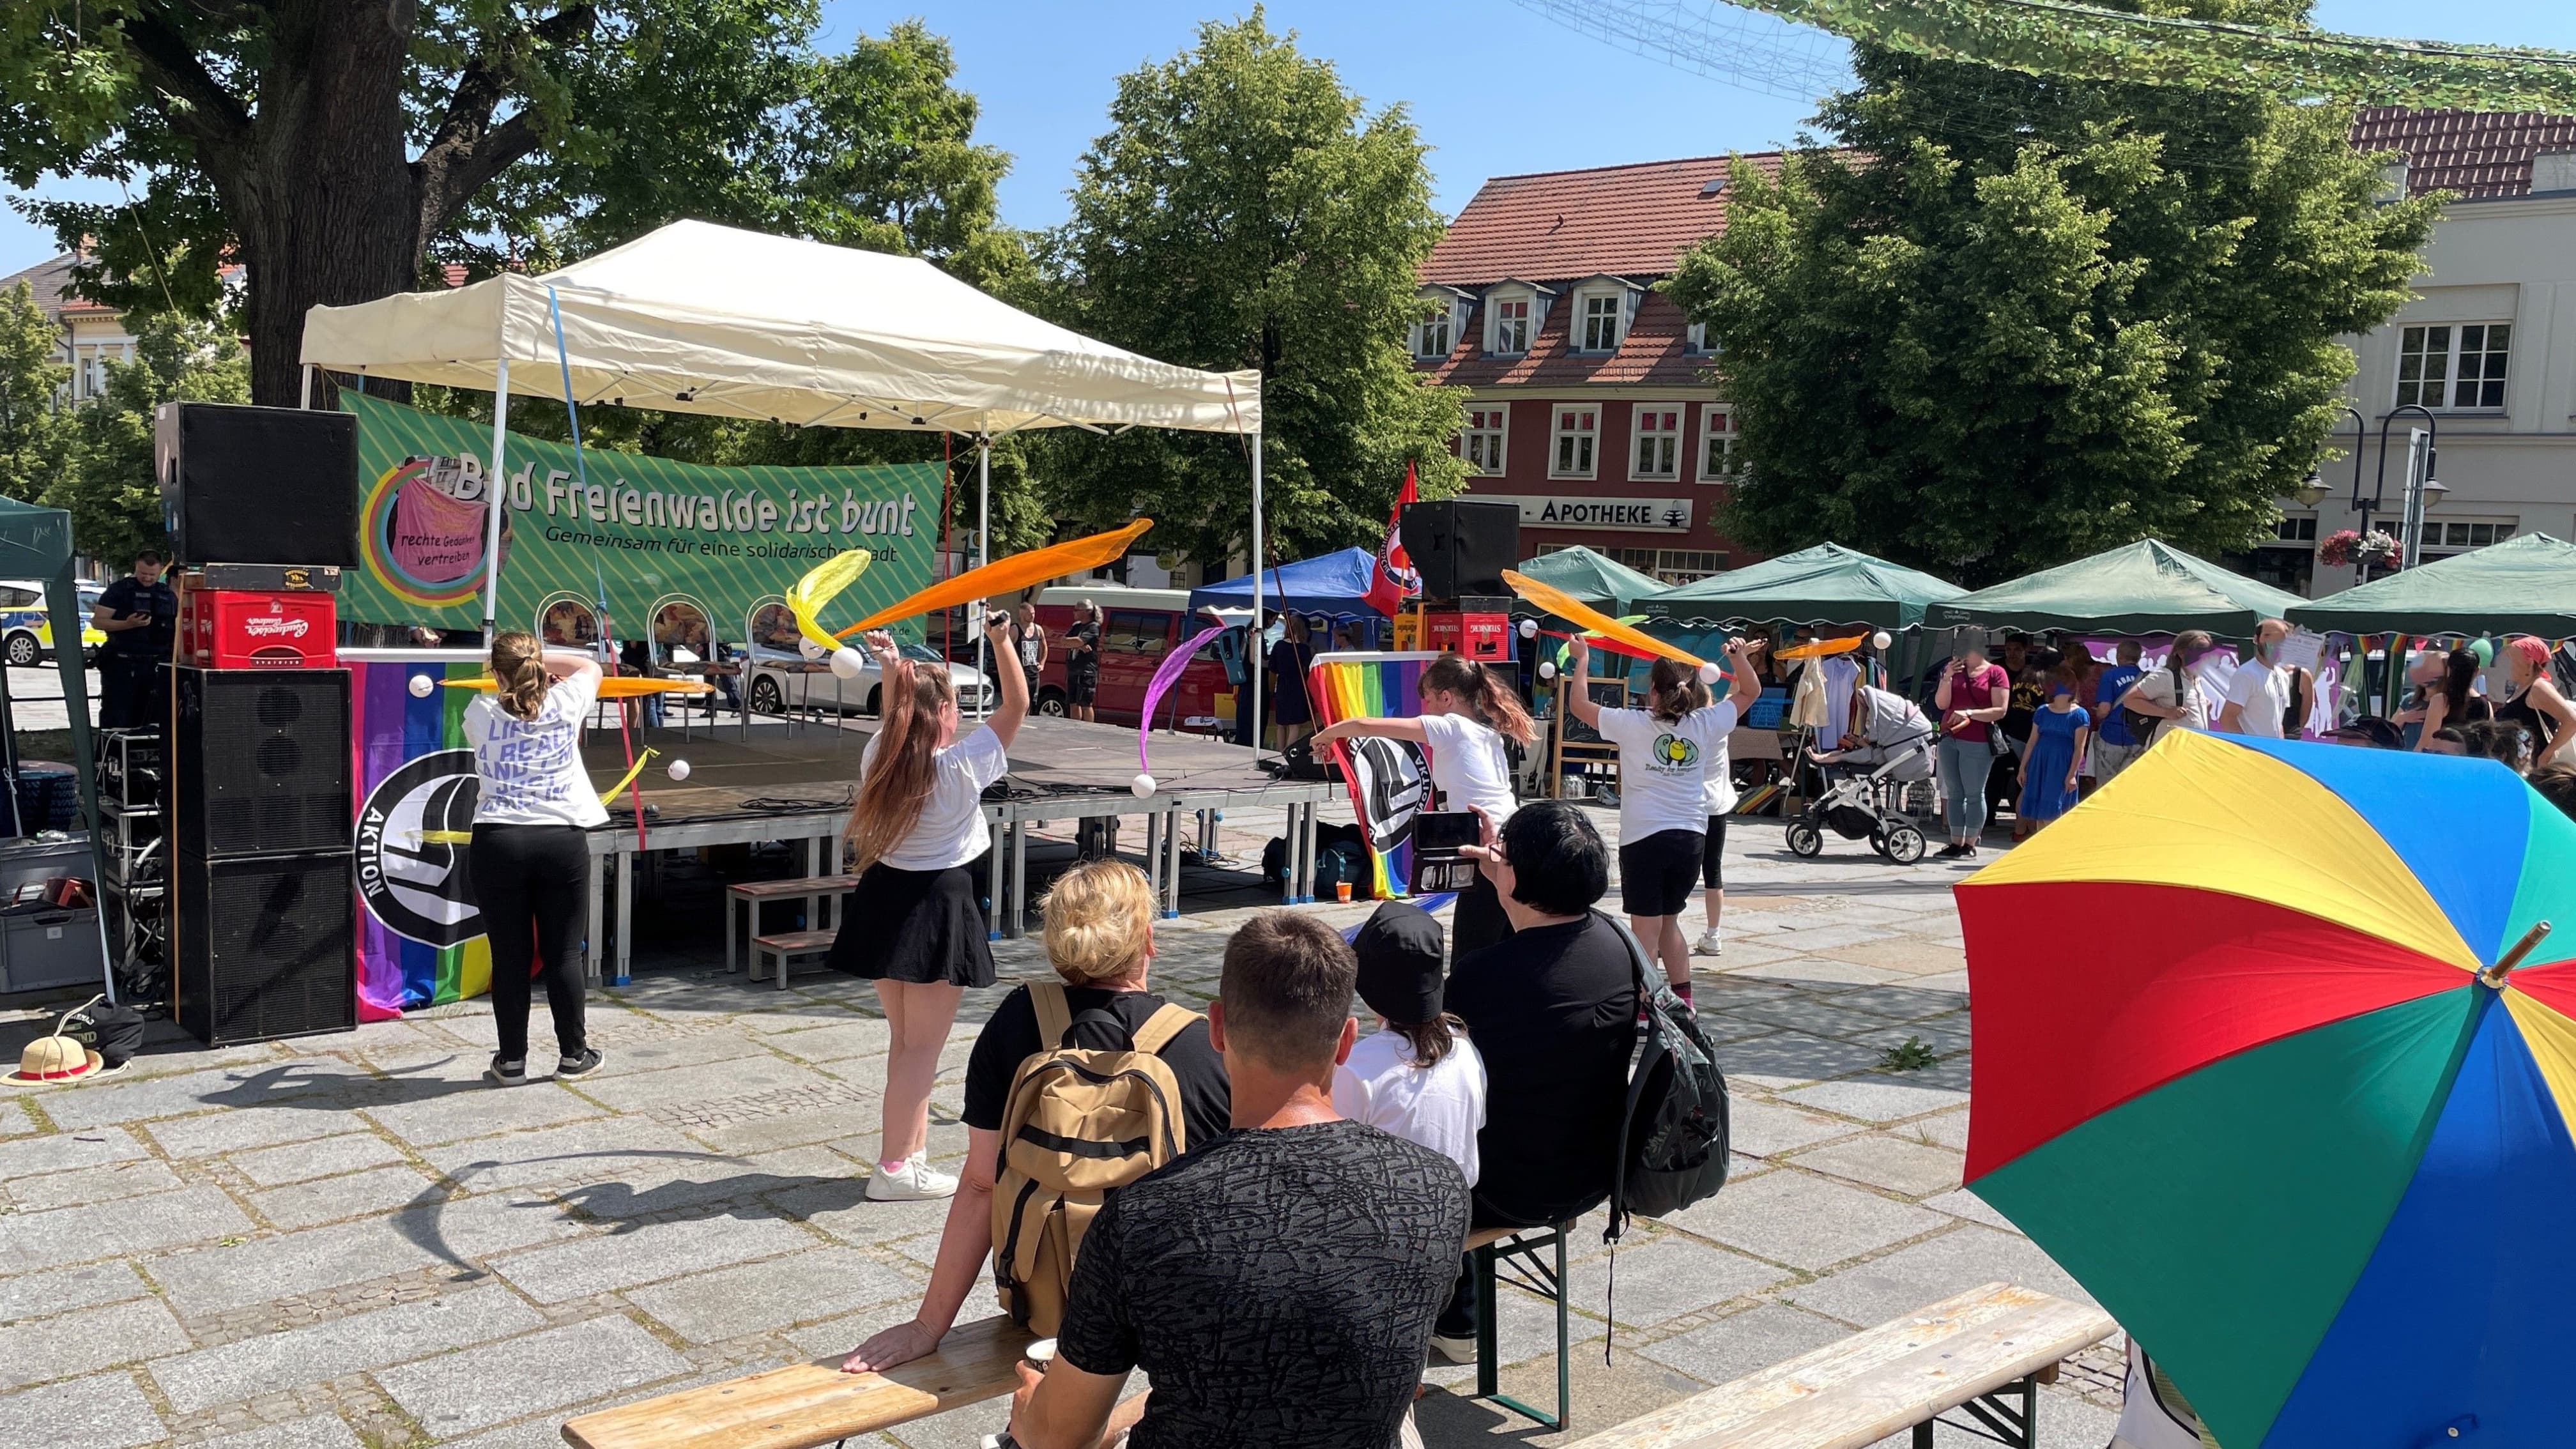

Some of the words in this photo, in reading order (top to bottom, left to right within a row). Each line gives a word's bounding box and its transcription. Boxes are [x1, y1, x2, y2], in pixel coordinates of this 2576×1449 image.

[546, 470, 779, 533] Freienwalde
[785, 488, 832, 534] ist
[840, 488, 917, 537] bunt
[1540, 499, 1652, 524] APOTHEKE
[401, 533, 440, 547] rechte
[546, 526, 661, 552] Gemeinsam
[666, 537, 695, 555] für
[700, 539, 740, 557] eine
[417, 551, 470, 566] vertreiben
[479, 744, 487, 760] A
[483, 760, 529, 781] AND
[360, 806, 385, 898] AKTION
